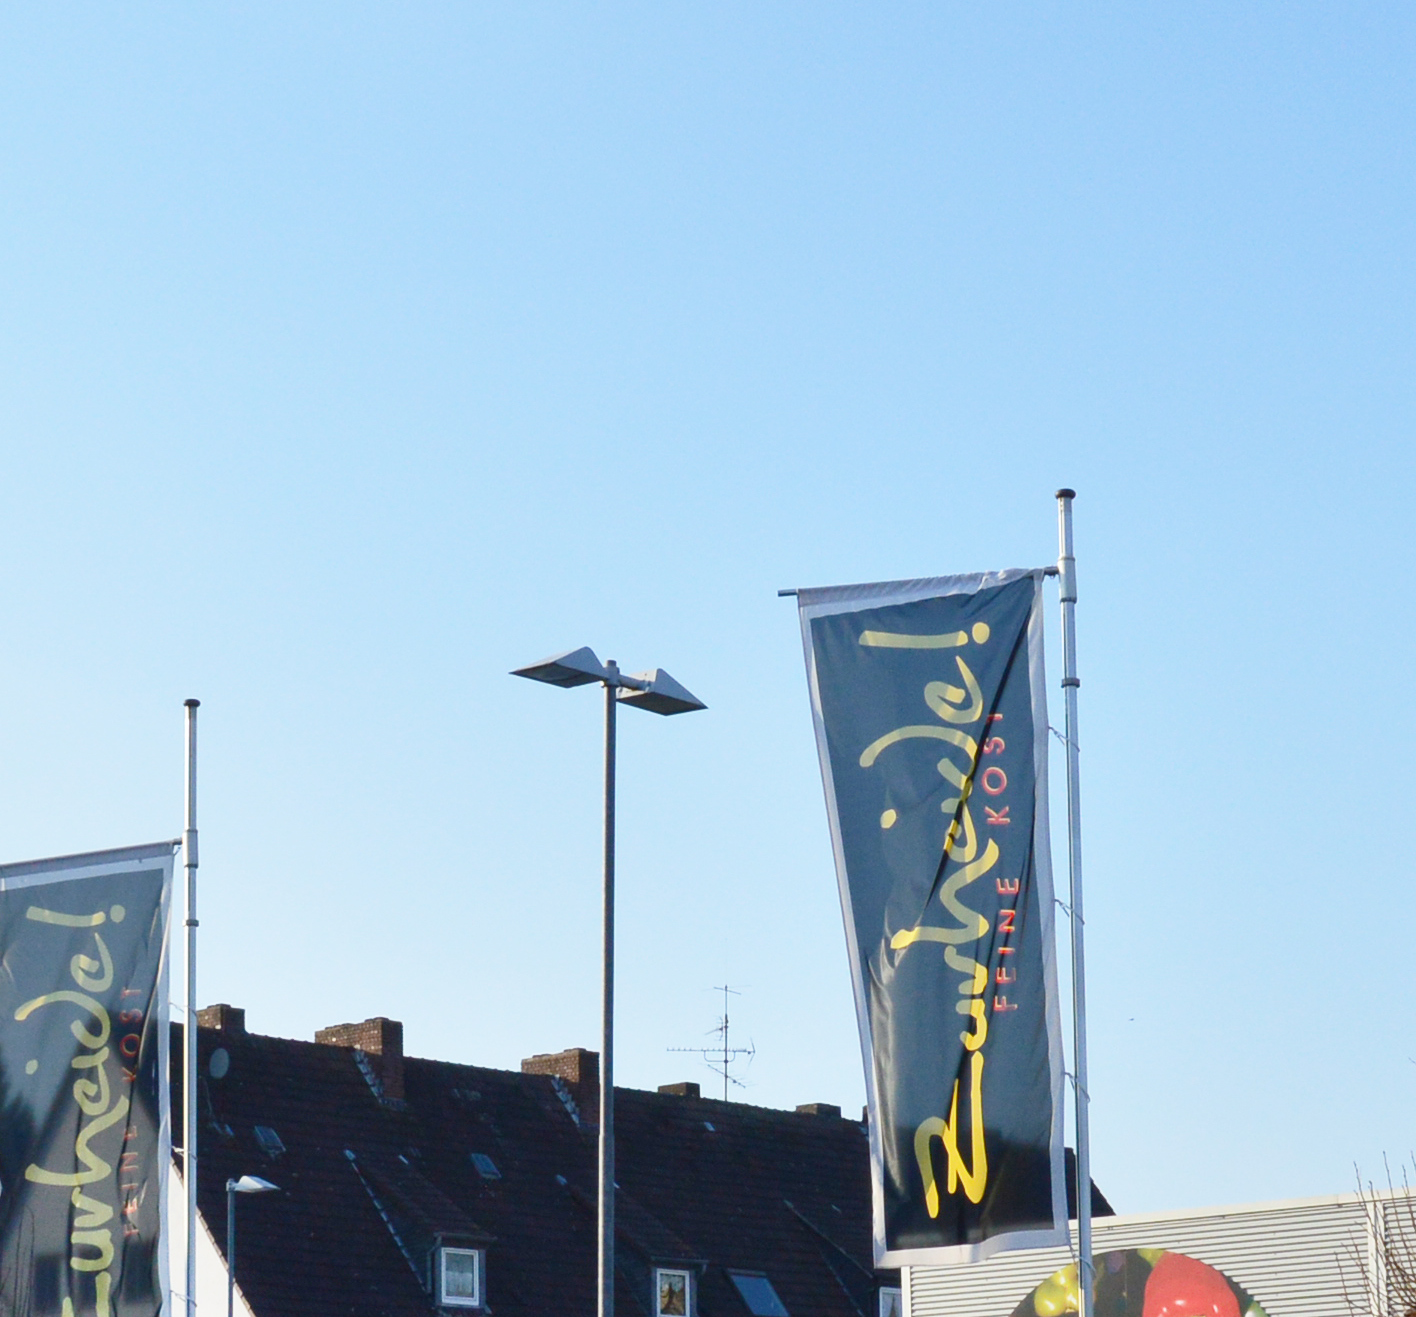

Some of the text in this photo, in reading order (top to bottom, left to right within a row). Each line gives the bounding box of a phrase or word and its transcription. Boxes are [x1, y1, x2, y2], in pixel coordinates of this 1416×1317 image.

[980, 712, 1021, 1013] FEINE KOST
[120, 1125, 140, 1237] FEINE
